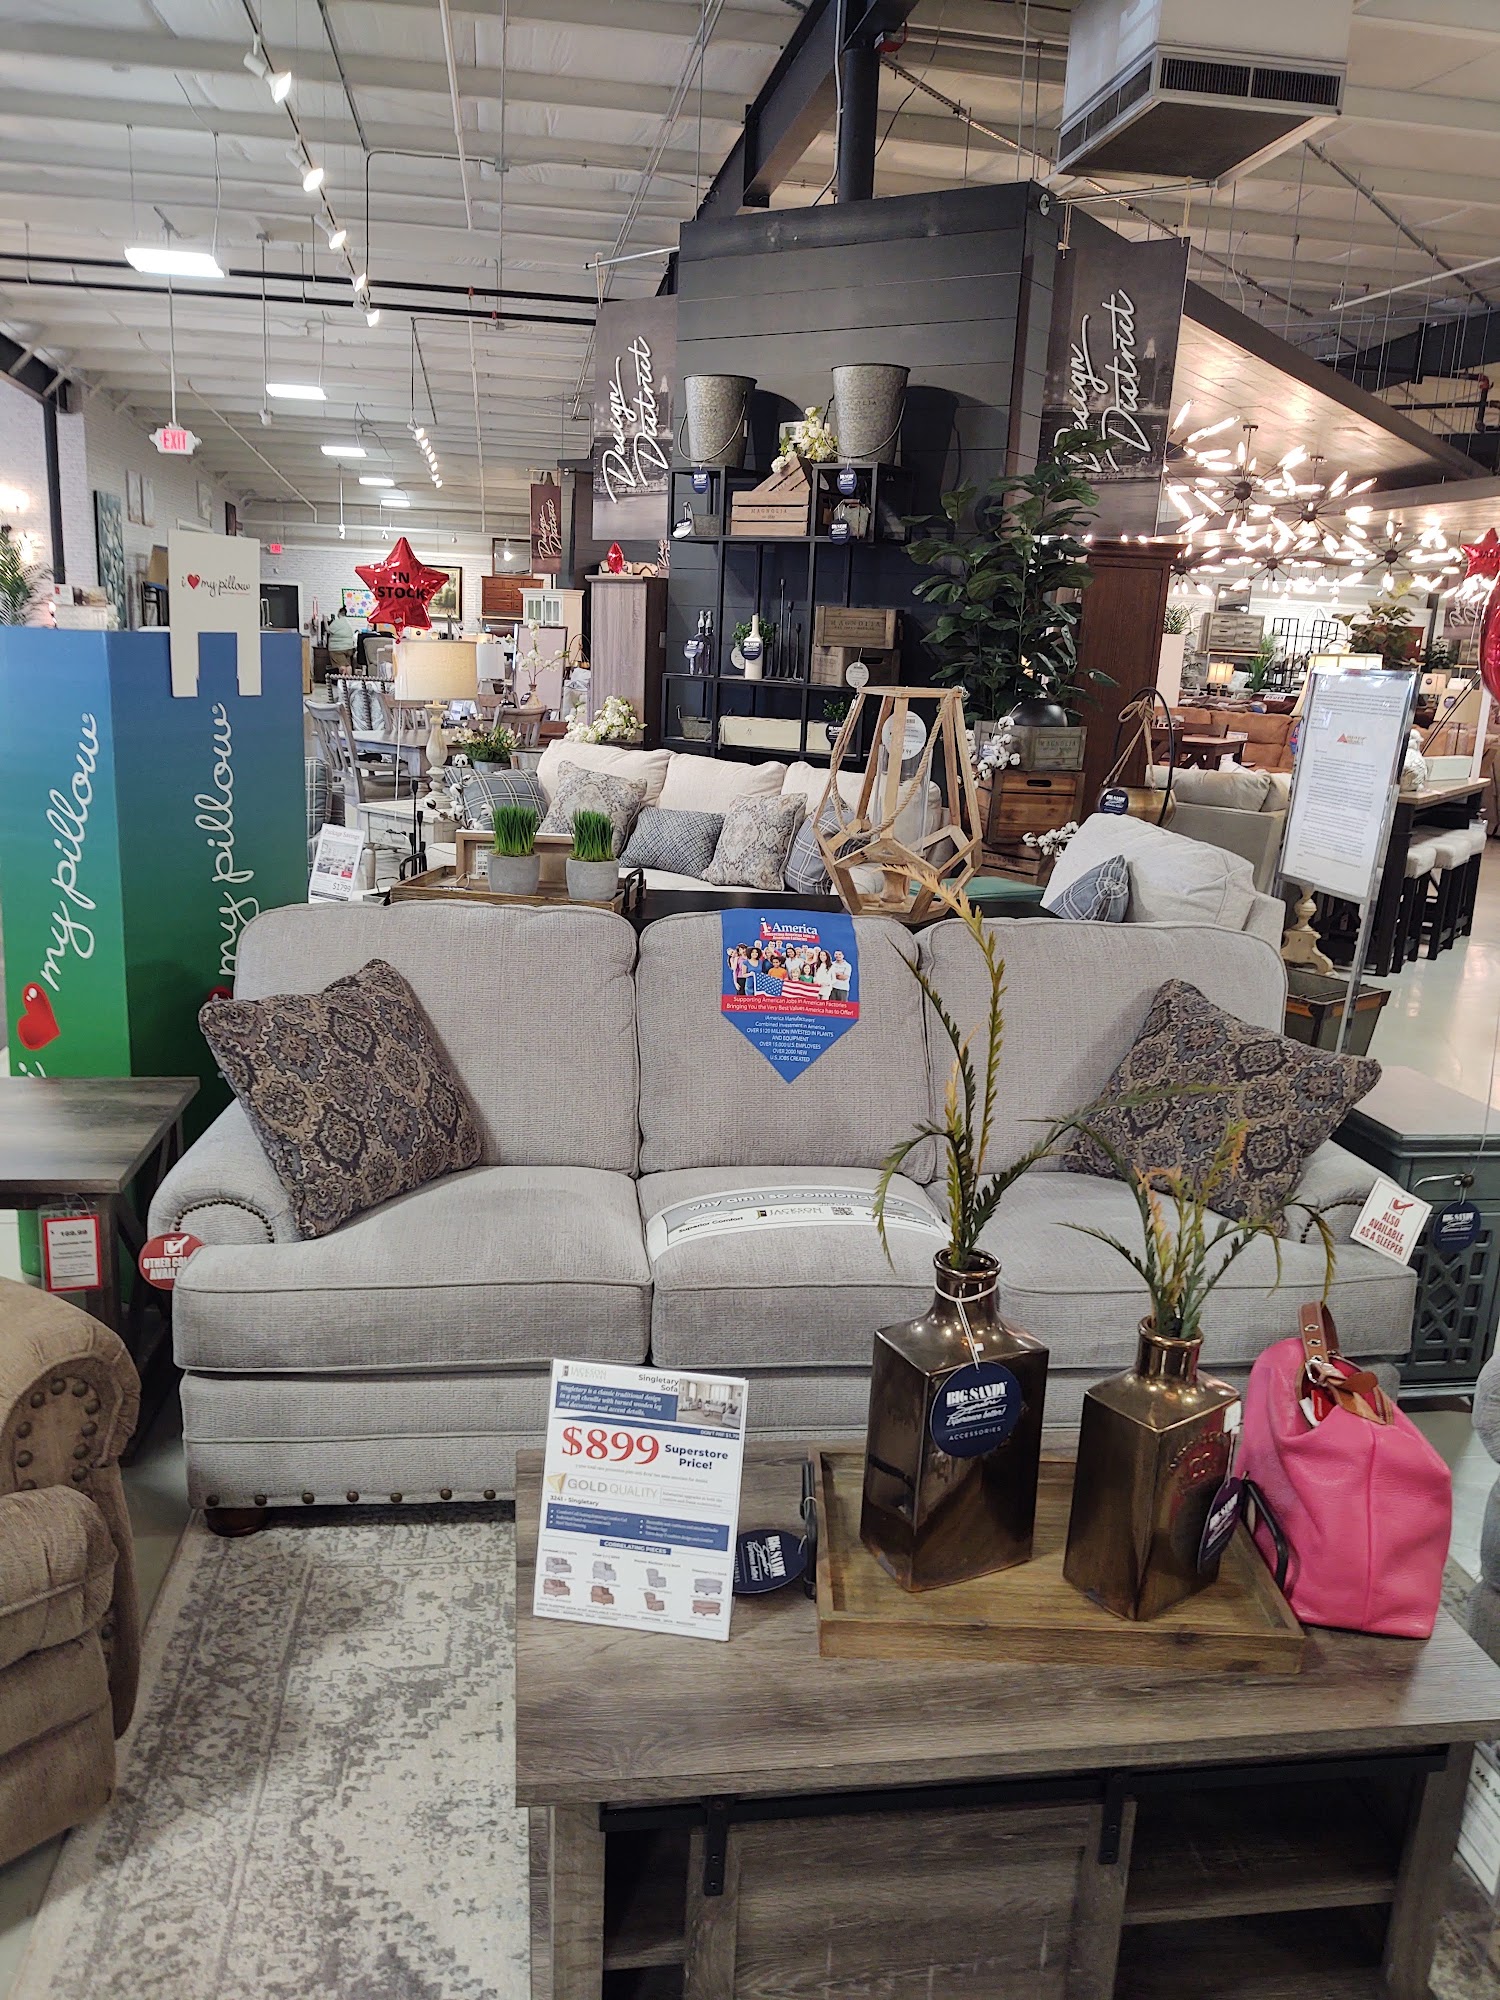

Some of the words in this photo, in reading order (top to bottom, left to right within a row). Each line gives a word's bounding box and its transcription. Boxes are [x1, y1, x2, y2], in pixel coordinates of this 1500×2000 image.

[1101, 288, 1151, 472] District
[628, 335, 669, 487] District
[602, 355, 638, 504] Design
[162, 429, 187, 450] EXIT
[201, 579, 216, 598] my
[218, 575, 251, 596] pillow
[393, 571, 410, 585] IN
[377, 587, 425, 600] STOCK
[193, 702, 254, 884] pillow
[46, 712, 99, 910] pillow
[40, 900, 95, 991] my
[687, 1200, 722, 1211] why
[769, 1207, 824, 1217] JACKSON
[1381, 1212, 1401, 1228] ALSO
[1368, 1217, 1405, 1243] AVAILABLE
[1359, 1226, 1370, 1239] AS
[1376, 1234, 1404, 1256] SLEEPER
[143, 1257, 172, 1269] OTHER
[638, 1373, 680, 1386] Singletary
[660, 1384, 678, 1393] Sofa
[946, 1389, 968, 1406] BIG
[968, 1381, 1007, 1402] SANDY
[948, 1426, 1001, 1440] ACCESSORIES
[562, 1426, 659, 1465] $899
[665, 1444, 729, 1460] Superstore
[679, 1458, 712, 1470] Price!
[568, 1478, 607, 1493] GOLD
[609, 1482, 658, 1499] QUALITY
[568, 1497, 599, 1506] Singletary
[604, 1541, 645, 1551] CORRELATING
[645, 1546, 667, 1555] PIECES
